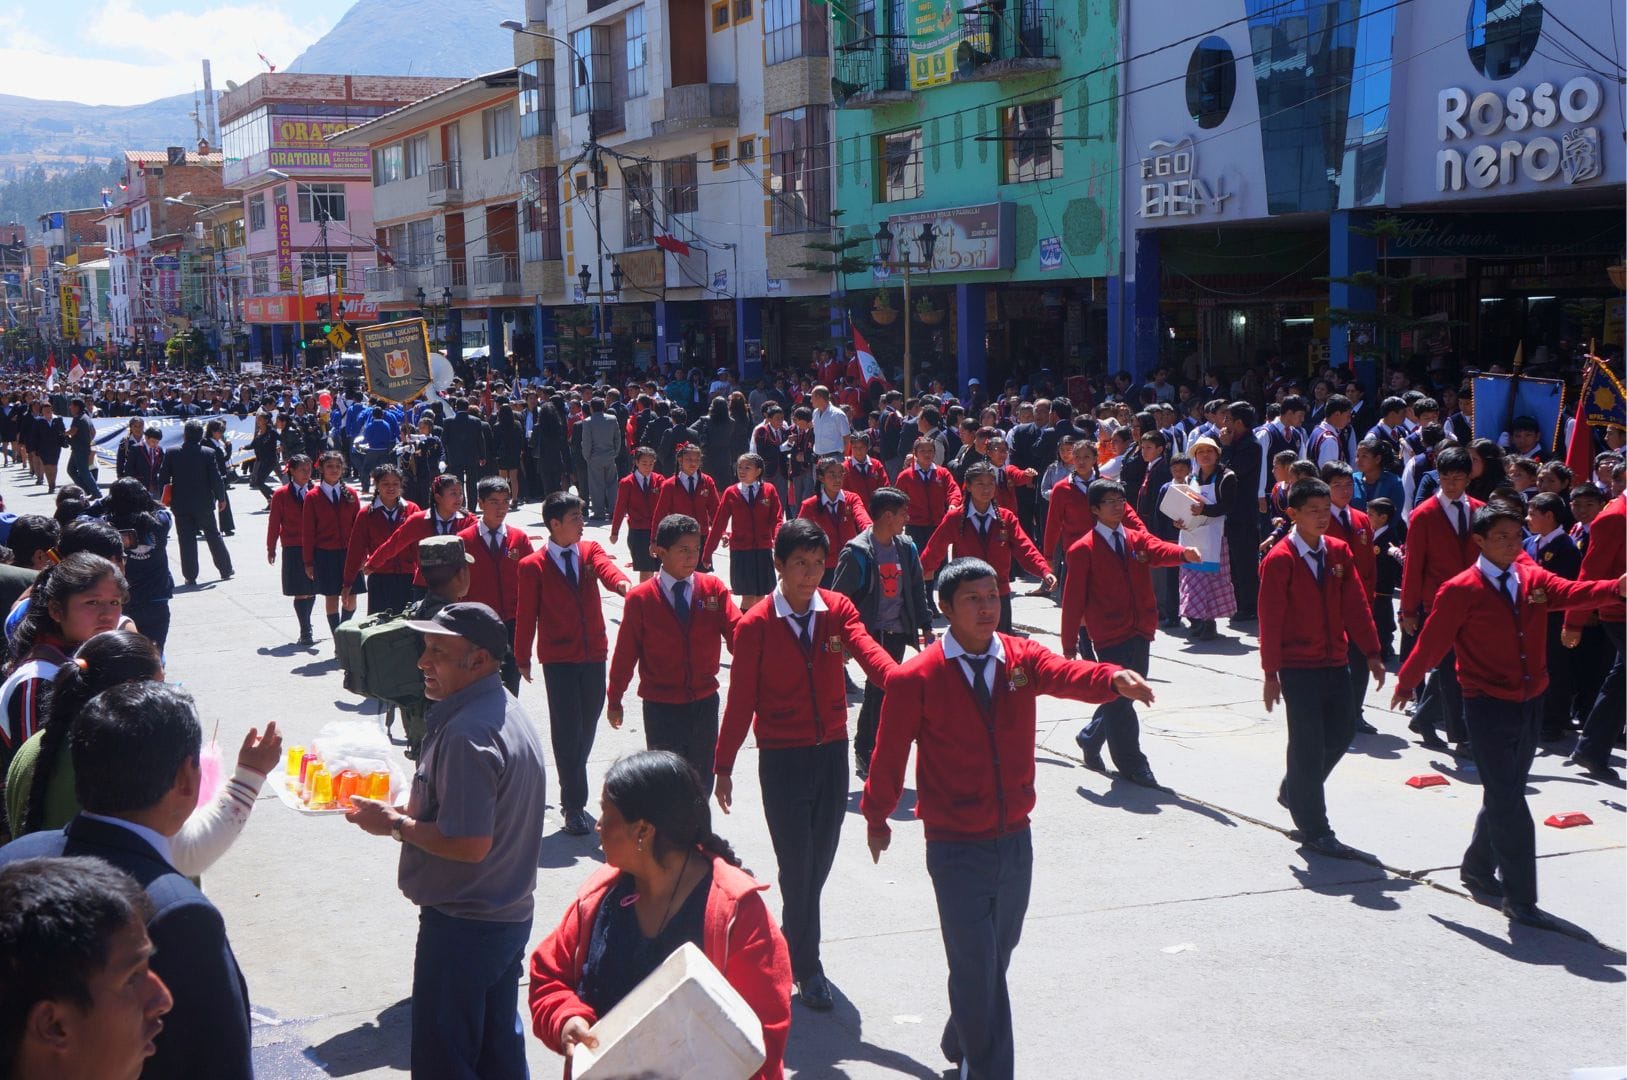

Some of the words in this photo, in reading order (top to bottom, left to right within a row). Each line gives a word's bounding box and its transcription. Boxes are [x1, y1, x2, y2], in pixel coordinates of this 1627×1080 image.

[270, 152, 331, 166] ORATORIA
[1140, 152, 1190, 177] EGO
[1436, 136, 1560, 192] nero
[278, 206, 292, 273] ORATORIA
